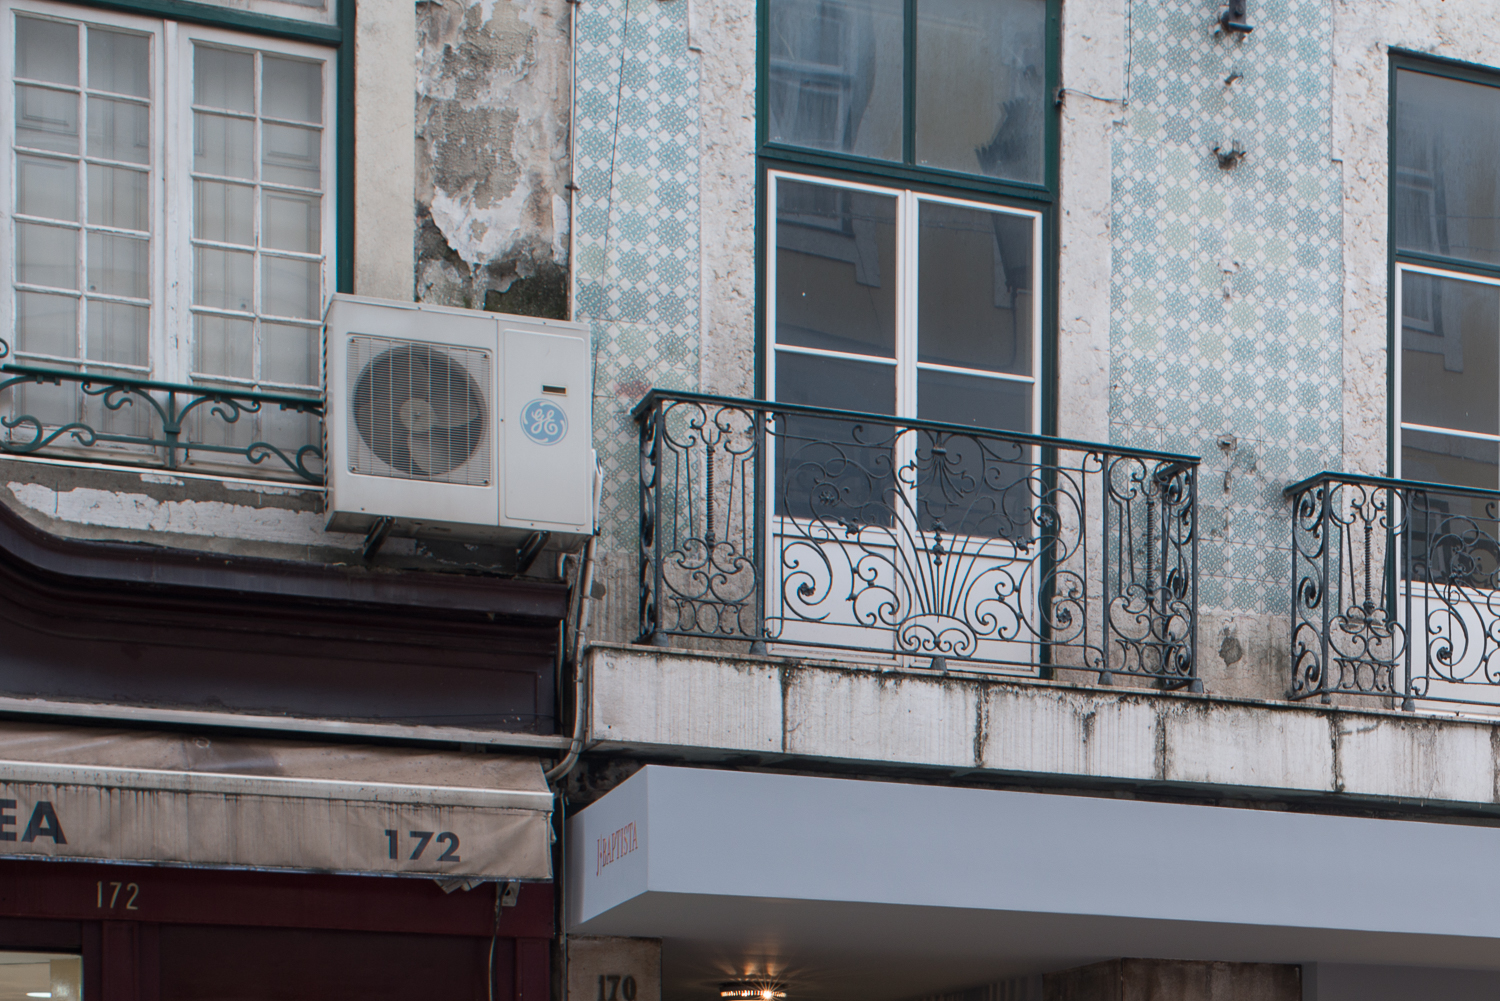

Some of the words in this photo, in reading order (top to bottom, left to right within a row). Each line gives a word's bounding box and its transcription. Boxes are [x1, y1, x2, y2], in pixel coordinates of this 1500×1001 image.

[384, 829, 461, 863] 172
[97, 880, 139, 910] 172
[598, 974, 637, 1001] 170
